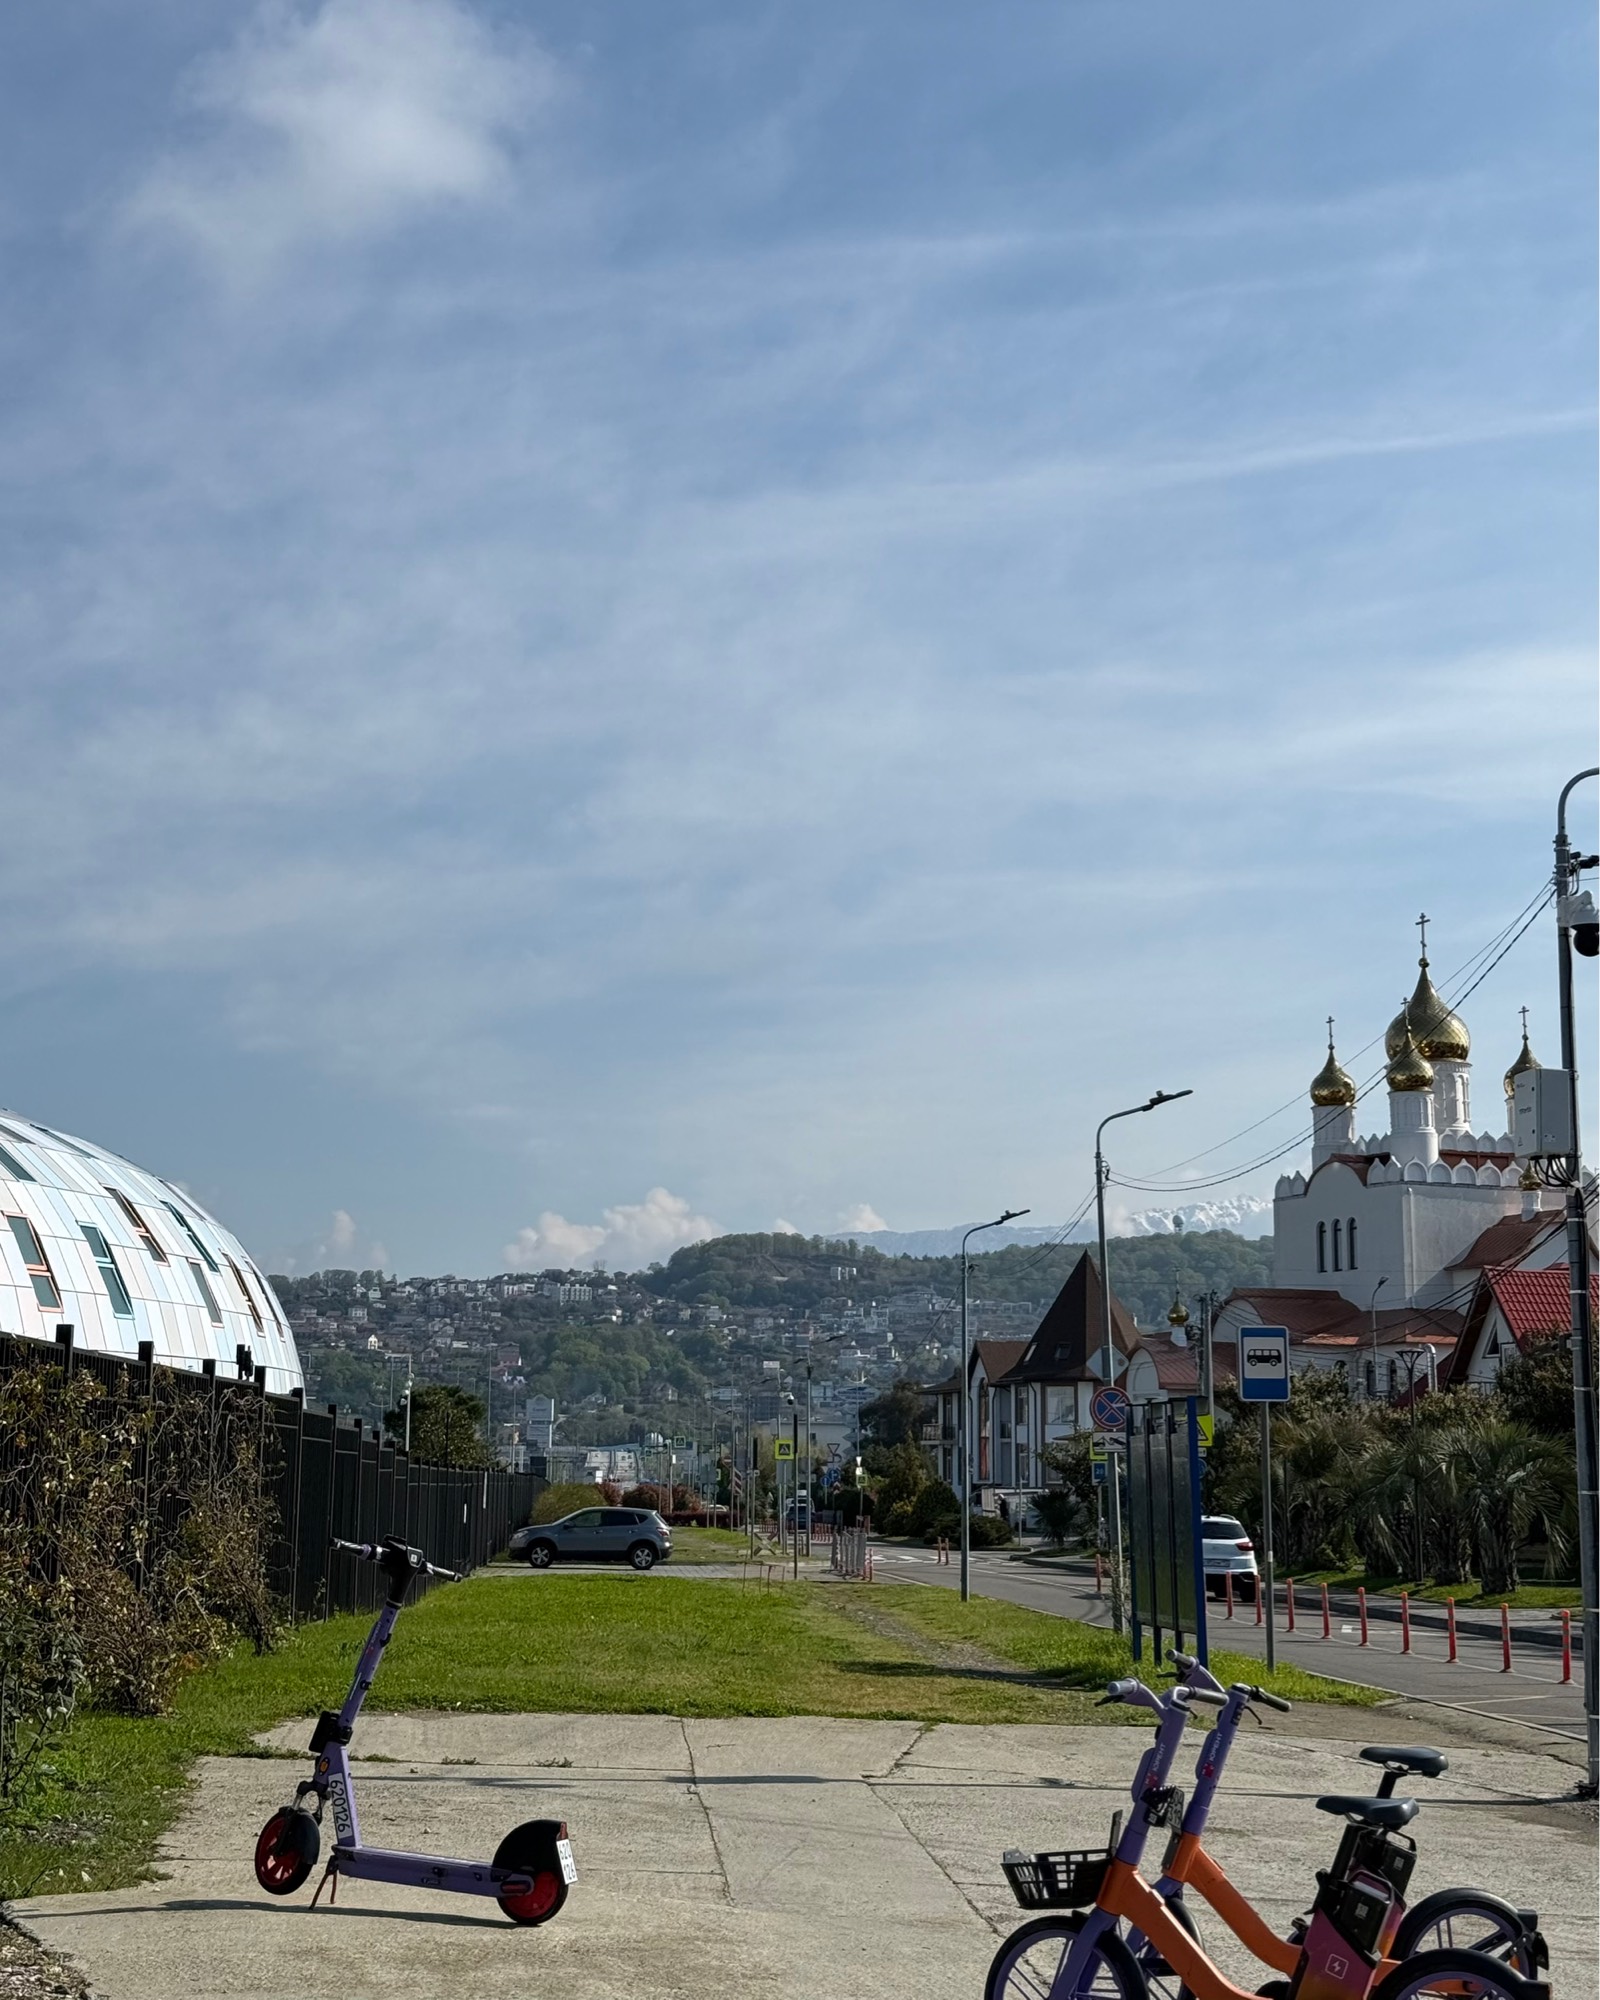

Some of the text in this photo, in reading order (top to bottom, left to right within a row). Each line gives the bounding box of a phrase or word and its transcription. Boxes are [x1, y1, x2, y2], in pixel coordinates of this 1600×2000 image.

[1153, 1743, 1166, 1771] ЮРЕНТ
[1209, 1733, 1222, 1761] ЮРЕНТ
[330, 1780, 350, 1833] 620126
[563, 1862, 575, 1880] 126
